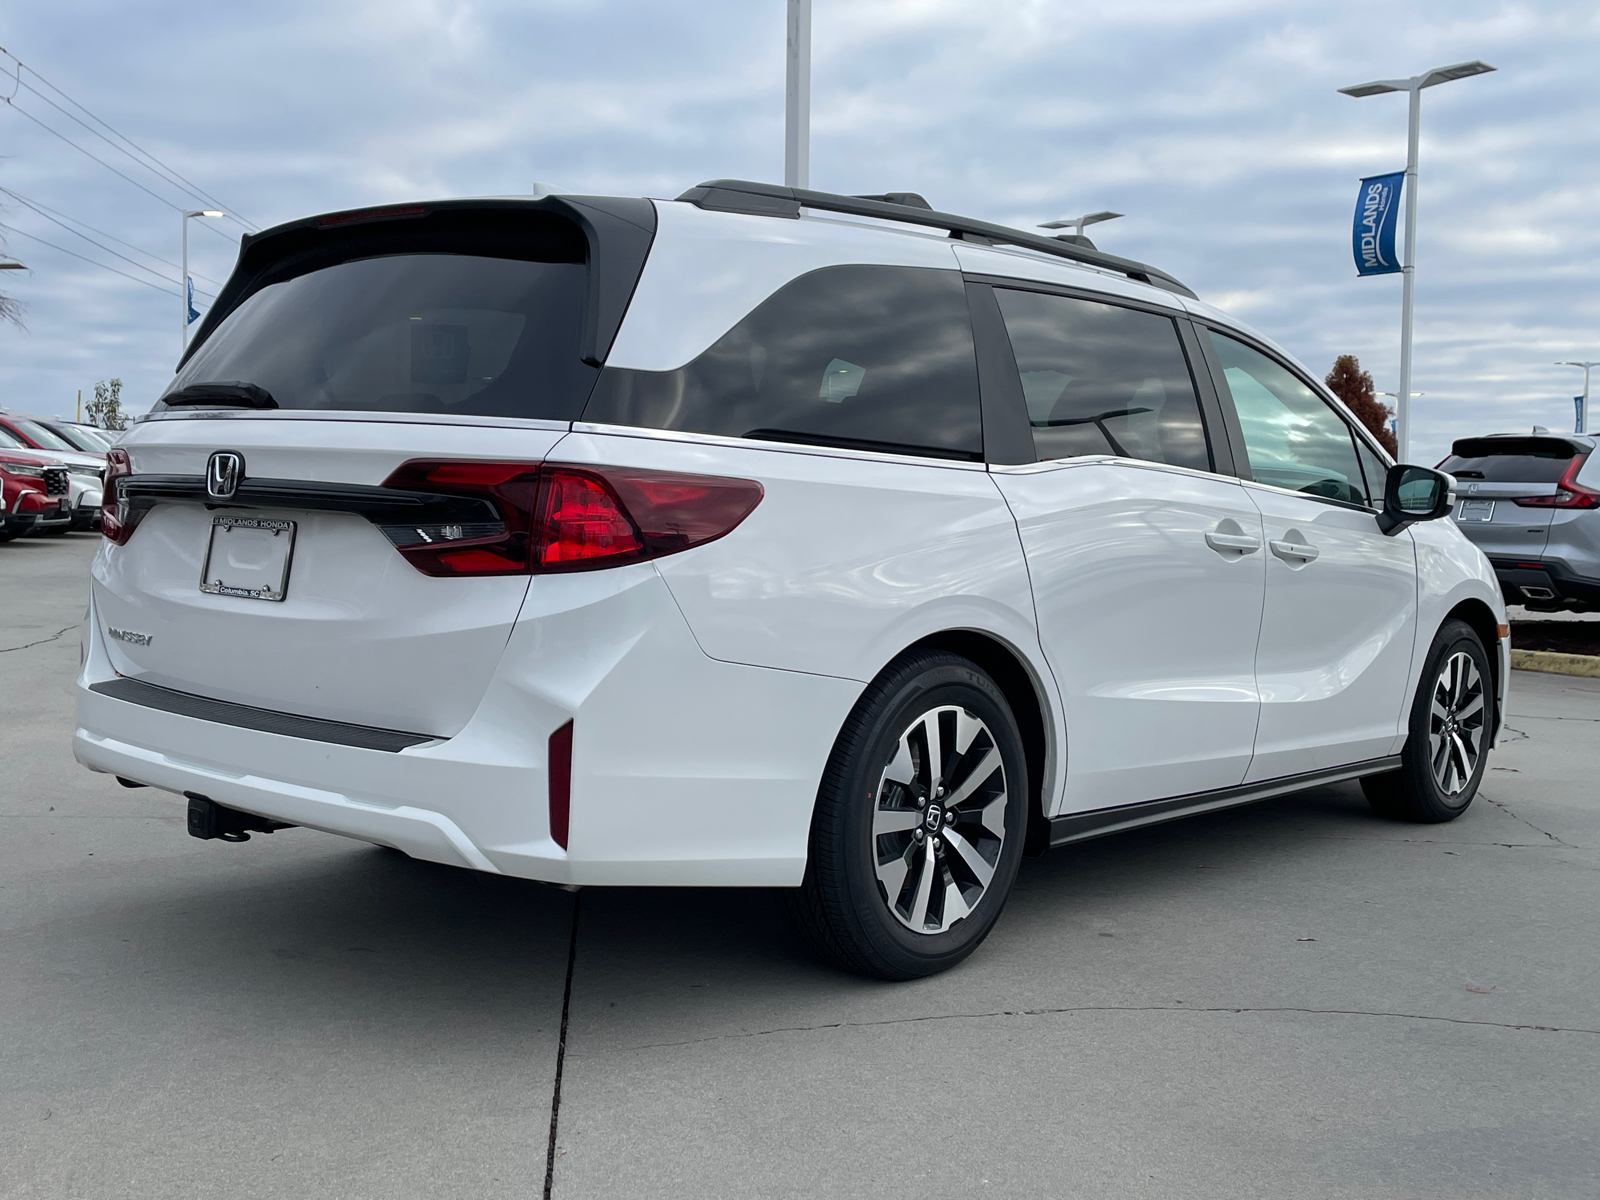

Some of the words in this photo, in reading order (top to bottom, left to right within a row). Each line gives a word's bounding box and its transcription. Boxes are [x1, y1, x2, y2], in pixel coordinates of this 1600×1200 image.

[1378, 187, 1389, 211] Honda
[1361, 183, 1382, 267] MIDLANDS
[220, 518, 258, 527] MIDLANDS
[260, 520, 289, 529] HONDA
